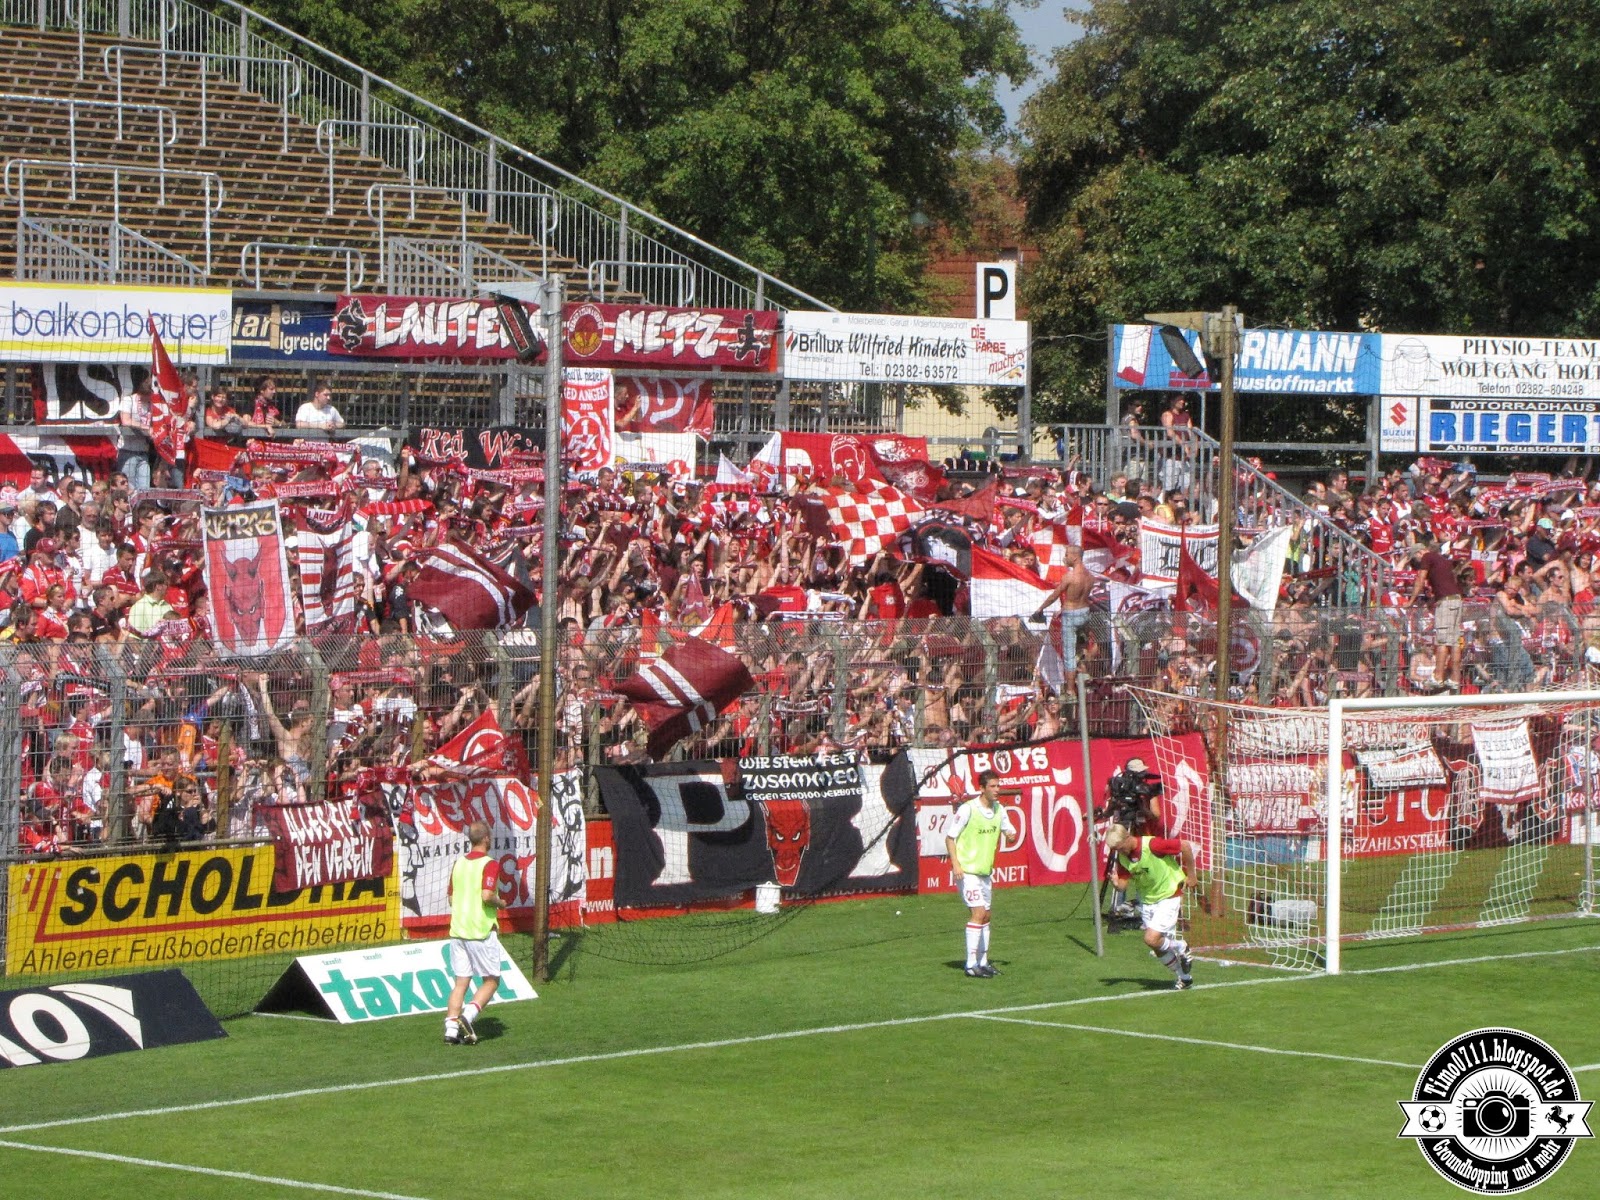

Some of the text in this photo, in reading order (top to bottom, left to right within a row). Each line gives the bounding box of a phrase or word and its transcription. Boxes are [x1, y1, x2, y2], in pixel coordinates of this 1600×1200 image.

[984, 268, 1009, 318] P
[614, 310, 724, 358] METZ
[800, 333, 843, 354] Brillux
[848, 333, 904, 360] Wilfried
[1463, 338, 1596, 358] PHYSIO-TEAM
[885, 364, 958, 379] 02382-63572
[1441, 360, 1548, 380] WOLFGANG
[579, 386, 608, 401] ANGELS
[1478, 382, 1584, 396] Telefon 02382-804248
[1450, 401, 1596, 412] MOTORRADHAUS
[1382, 429, 1415, 437] SUZUKI
[1430, 412, 1600, 443] RIEGER
[420, 428, 468, 461] Red
[739, 757, 770, 769] WIR
[325, 835, 375, 880] VEREIN
[927, 877, 939, 887] IM
[966, 890, 980, 901] 25
[20, 917, 386, 973] Ahlener Fußbodenfachbetrieb
